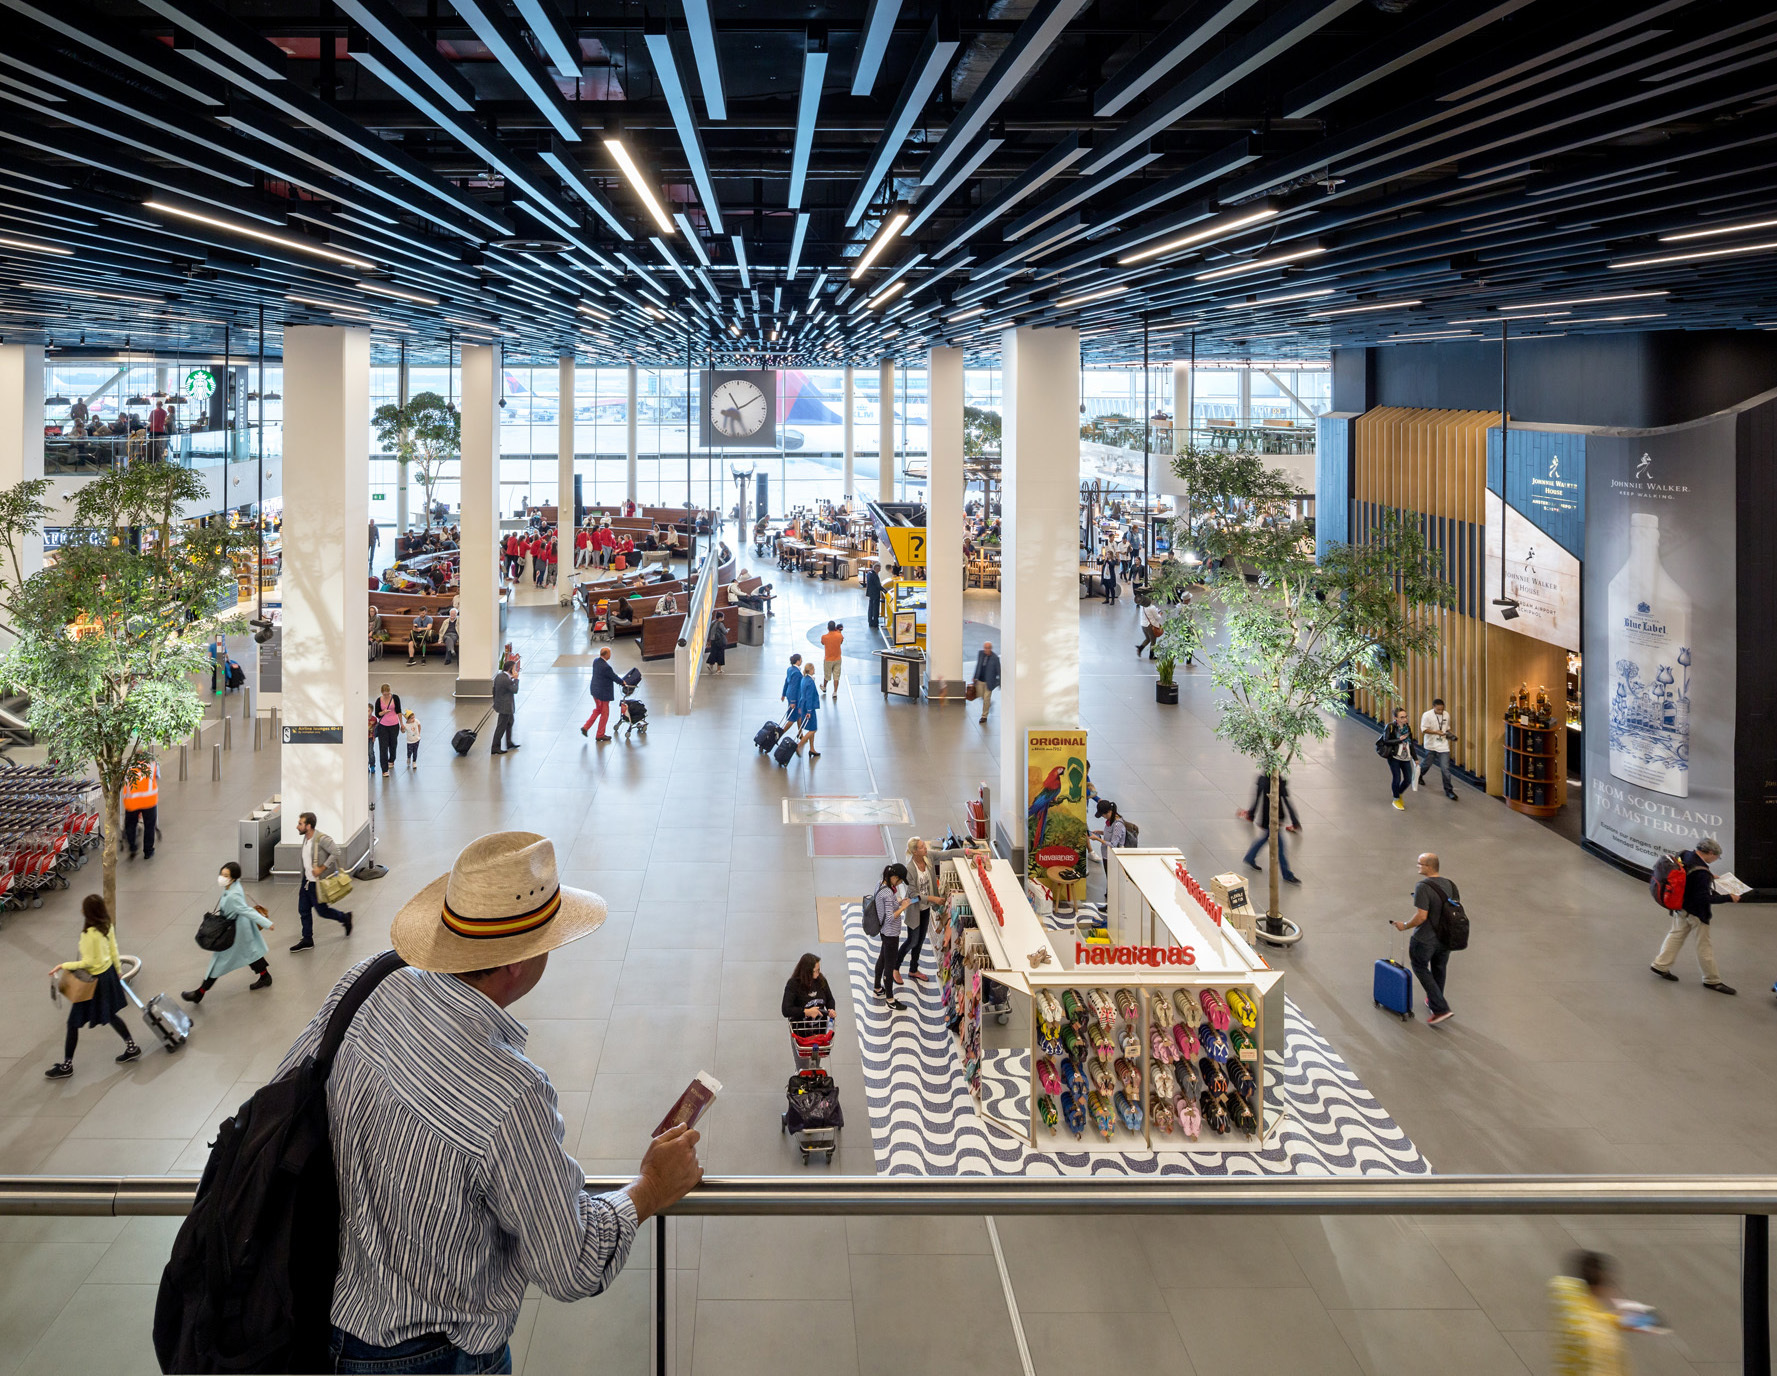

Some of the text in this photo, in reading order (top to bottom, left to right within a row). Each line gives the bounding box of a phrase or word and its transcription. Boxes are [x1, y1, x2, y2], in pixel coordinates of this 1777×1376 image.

[1610, 479, 1644, 490] JOHNNIE
[1545, 487, 1563, 496] HOUSE
[1519, 584, 1540, 596] HOUSE
[1531, 577, 1558, 590] WALKER
[1535, 605, 1556, 616] AIRPORT
[1623, 617, 1666, 634] Blue Label
[1030, 737, 1085, 746] ORIGINAL
[1592, 778, 1723, 827] FROM SCOTLAND
[1595, 793, 1718, 841] TO AMSTERDAM
[1600, 821, 1618, 835] Explore
[1619, 831, 1629, 839] our
[1629, 835, 1652, 849] ranges
[1612, 835, 1658, 858] blended Scotch
[1038, 853, 1075, 861] havaianas
[1075, 941, 1196, 967] havaianas
